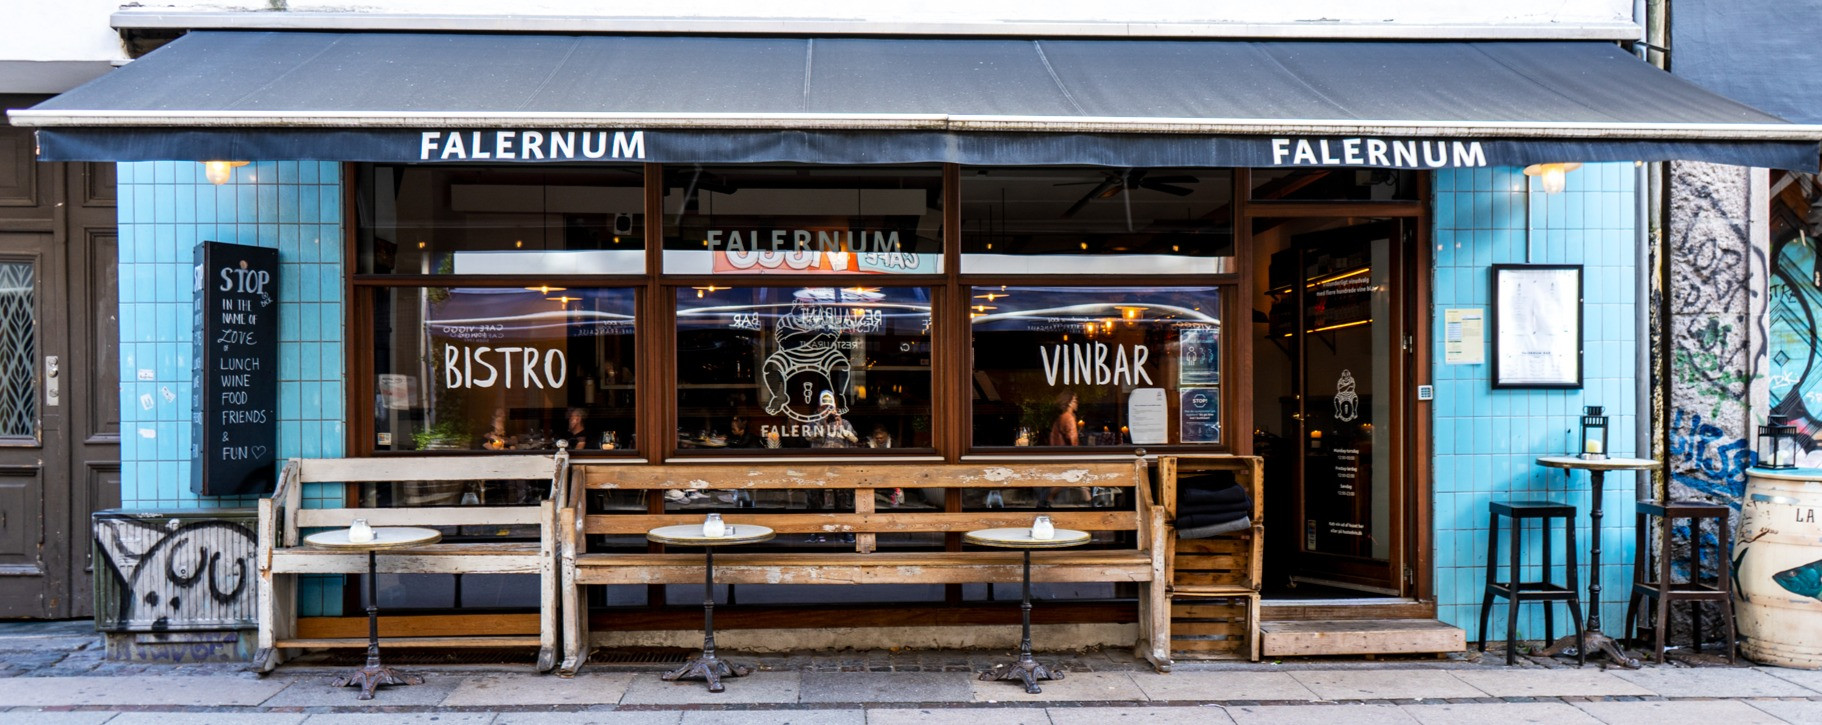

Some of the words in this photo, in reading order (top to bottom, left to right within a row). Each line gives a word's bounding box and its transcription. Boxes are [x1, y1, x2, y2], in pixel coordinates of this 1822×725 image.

[420, 131, 646, 160] FALERNUM
[1271, 138, 1488, 167] FALERNUM
[707, 230, 900, 252] FALERNUM
[220, 267, 270, 294] STOP
[222, 299, 233, 310] IN
[238, 299, 252, 311] THE
[222, 313, 246, 325] NAME
[248, 314, 258, 325] OF
[217, 329, 258, 345] LOVE
[220, 357, 260, 371] LUNCH
[445, 343, 566, 389] BISTRO
[1040, 341, 1153, 387] VINBAR
[221, 374, 251, 387] WINE
[222, 391, 248, 405] FOOD
[222, 410, 267, 425] FRIENDS
[222, 431, 229, 442] &
[761, 425, 854, 438] FALERNUM
[223, 446, 248, 460] FUN
